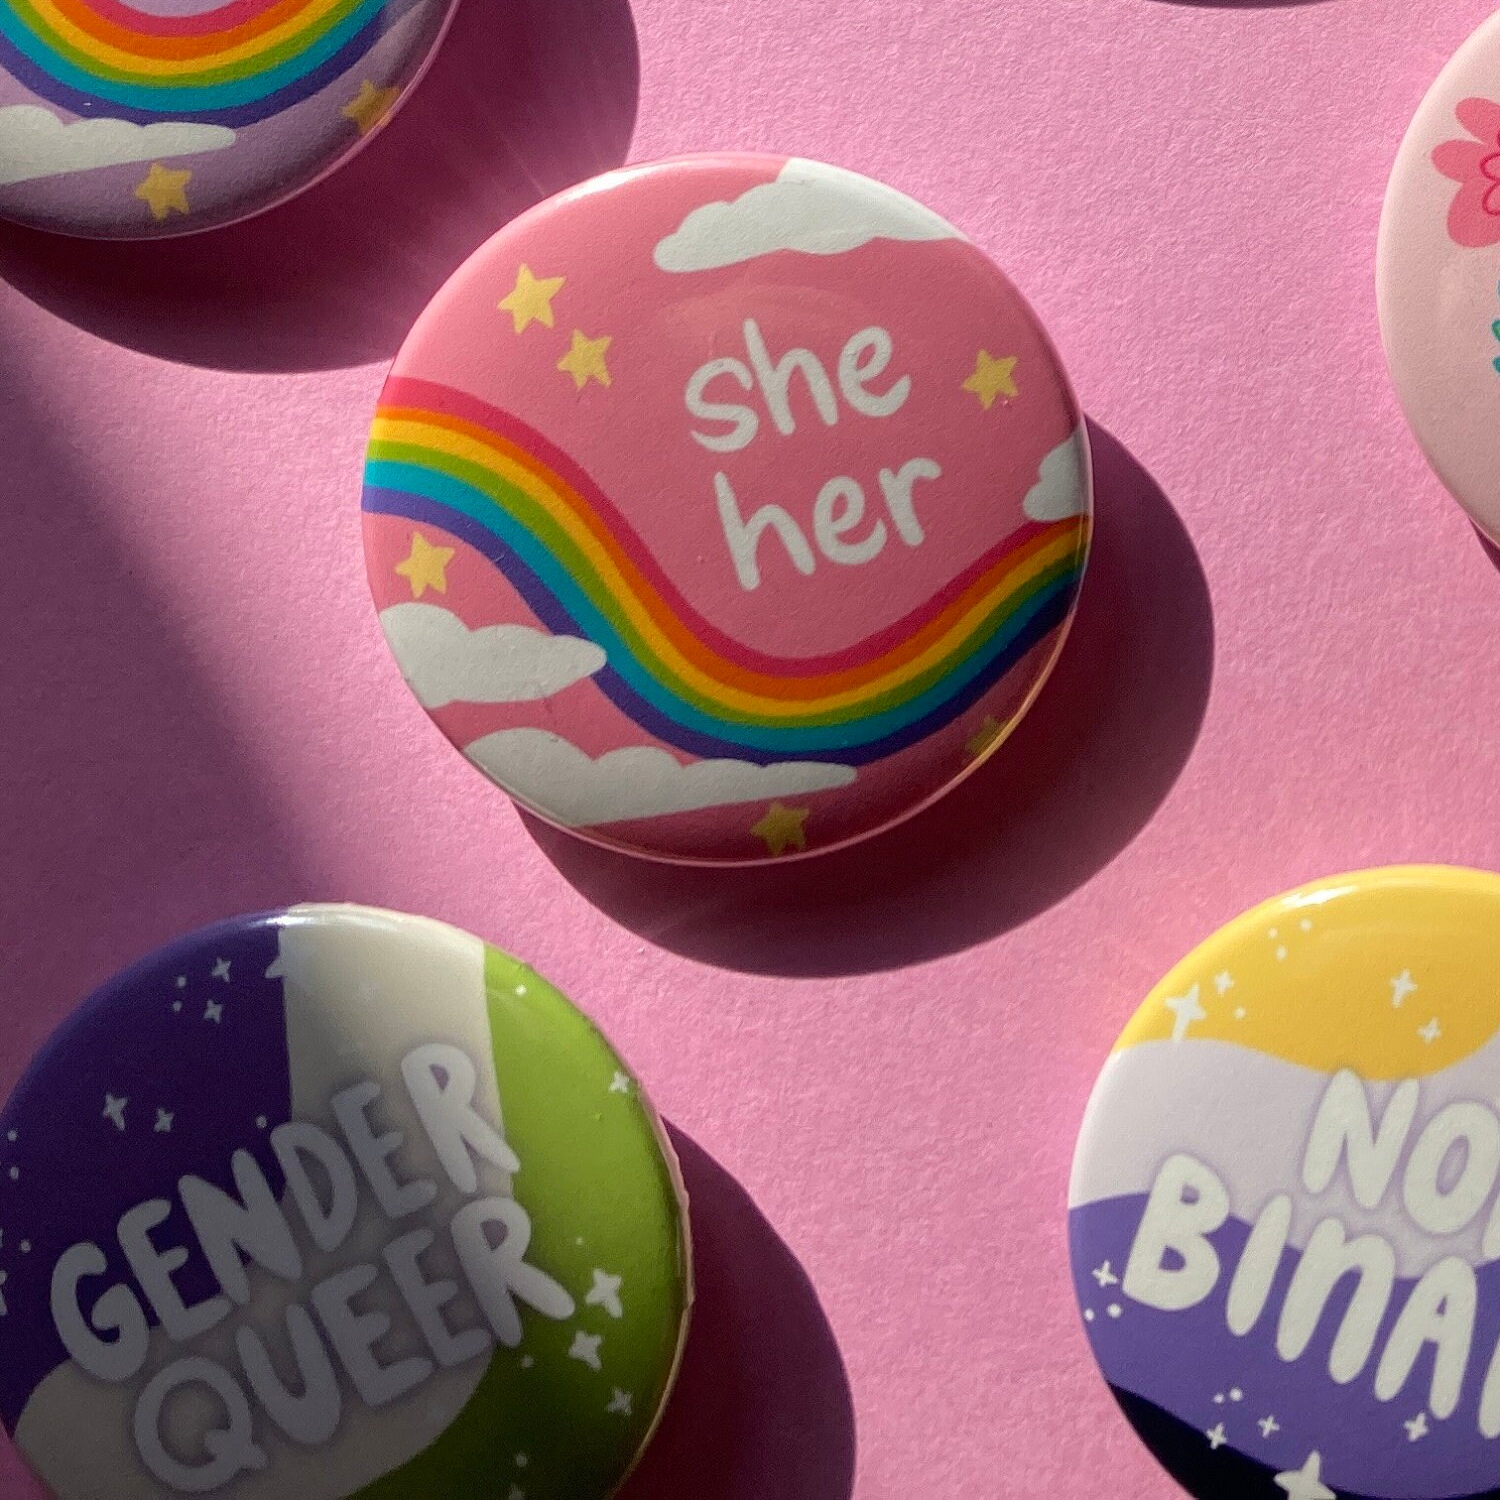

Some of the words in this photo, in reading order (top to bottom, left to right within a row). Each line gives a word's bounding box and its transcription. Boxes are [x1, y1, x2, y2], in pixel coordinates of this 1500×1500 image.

[685, 318, 912, 453] she
[713, 455, 941, 591] her
[51, 1043, 520, 1381] GENDER
[134, 1197, 575, 1494] QUEER
